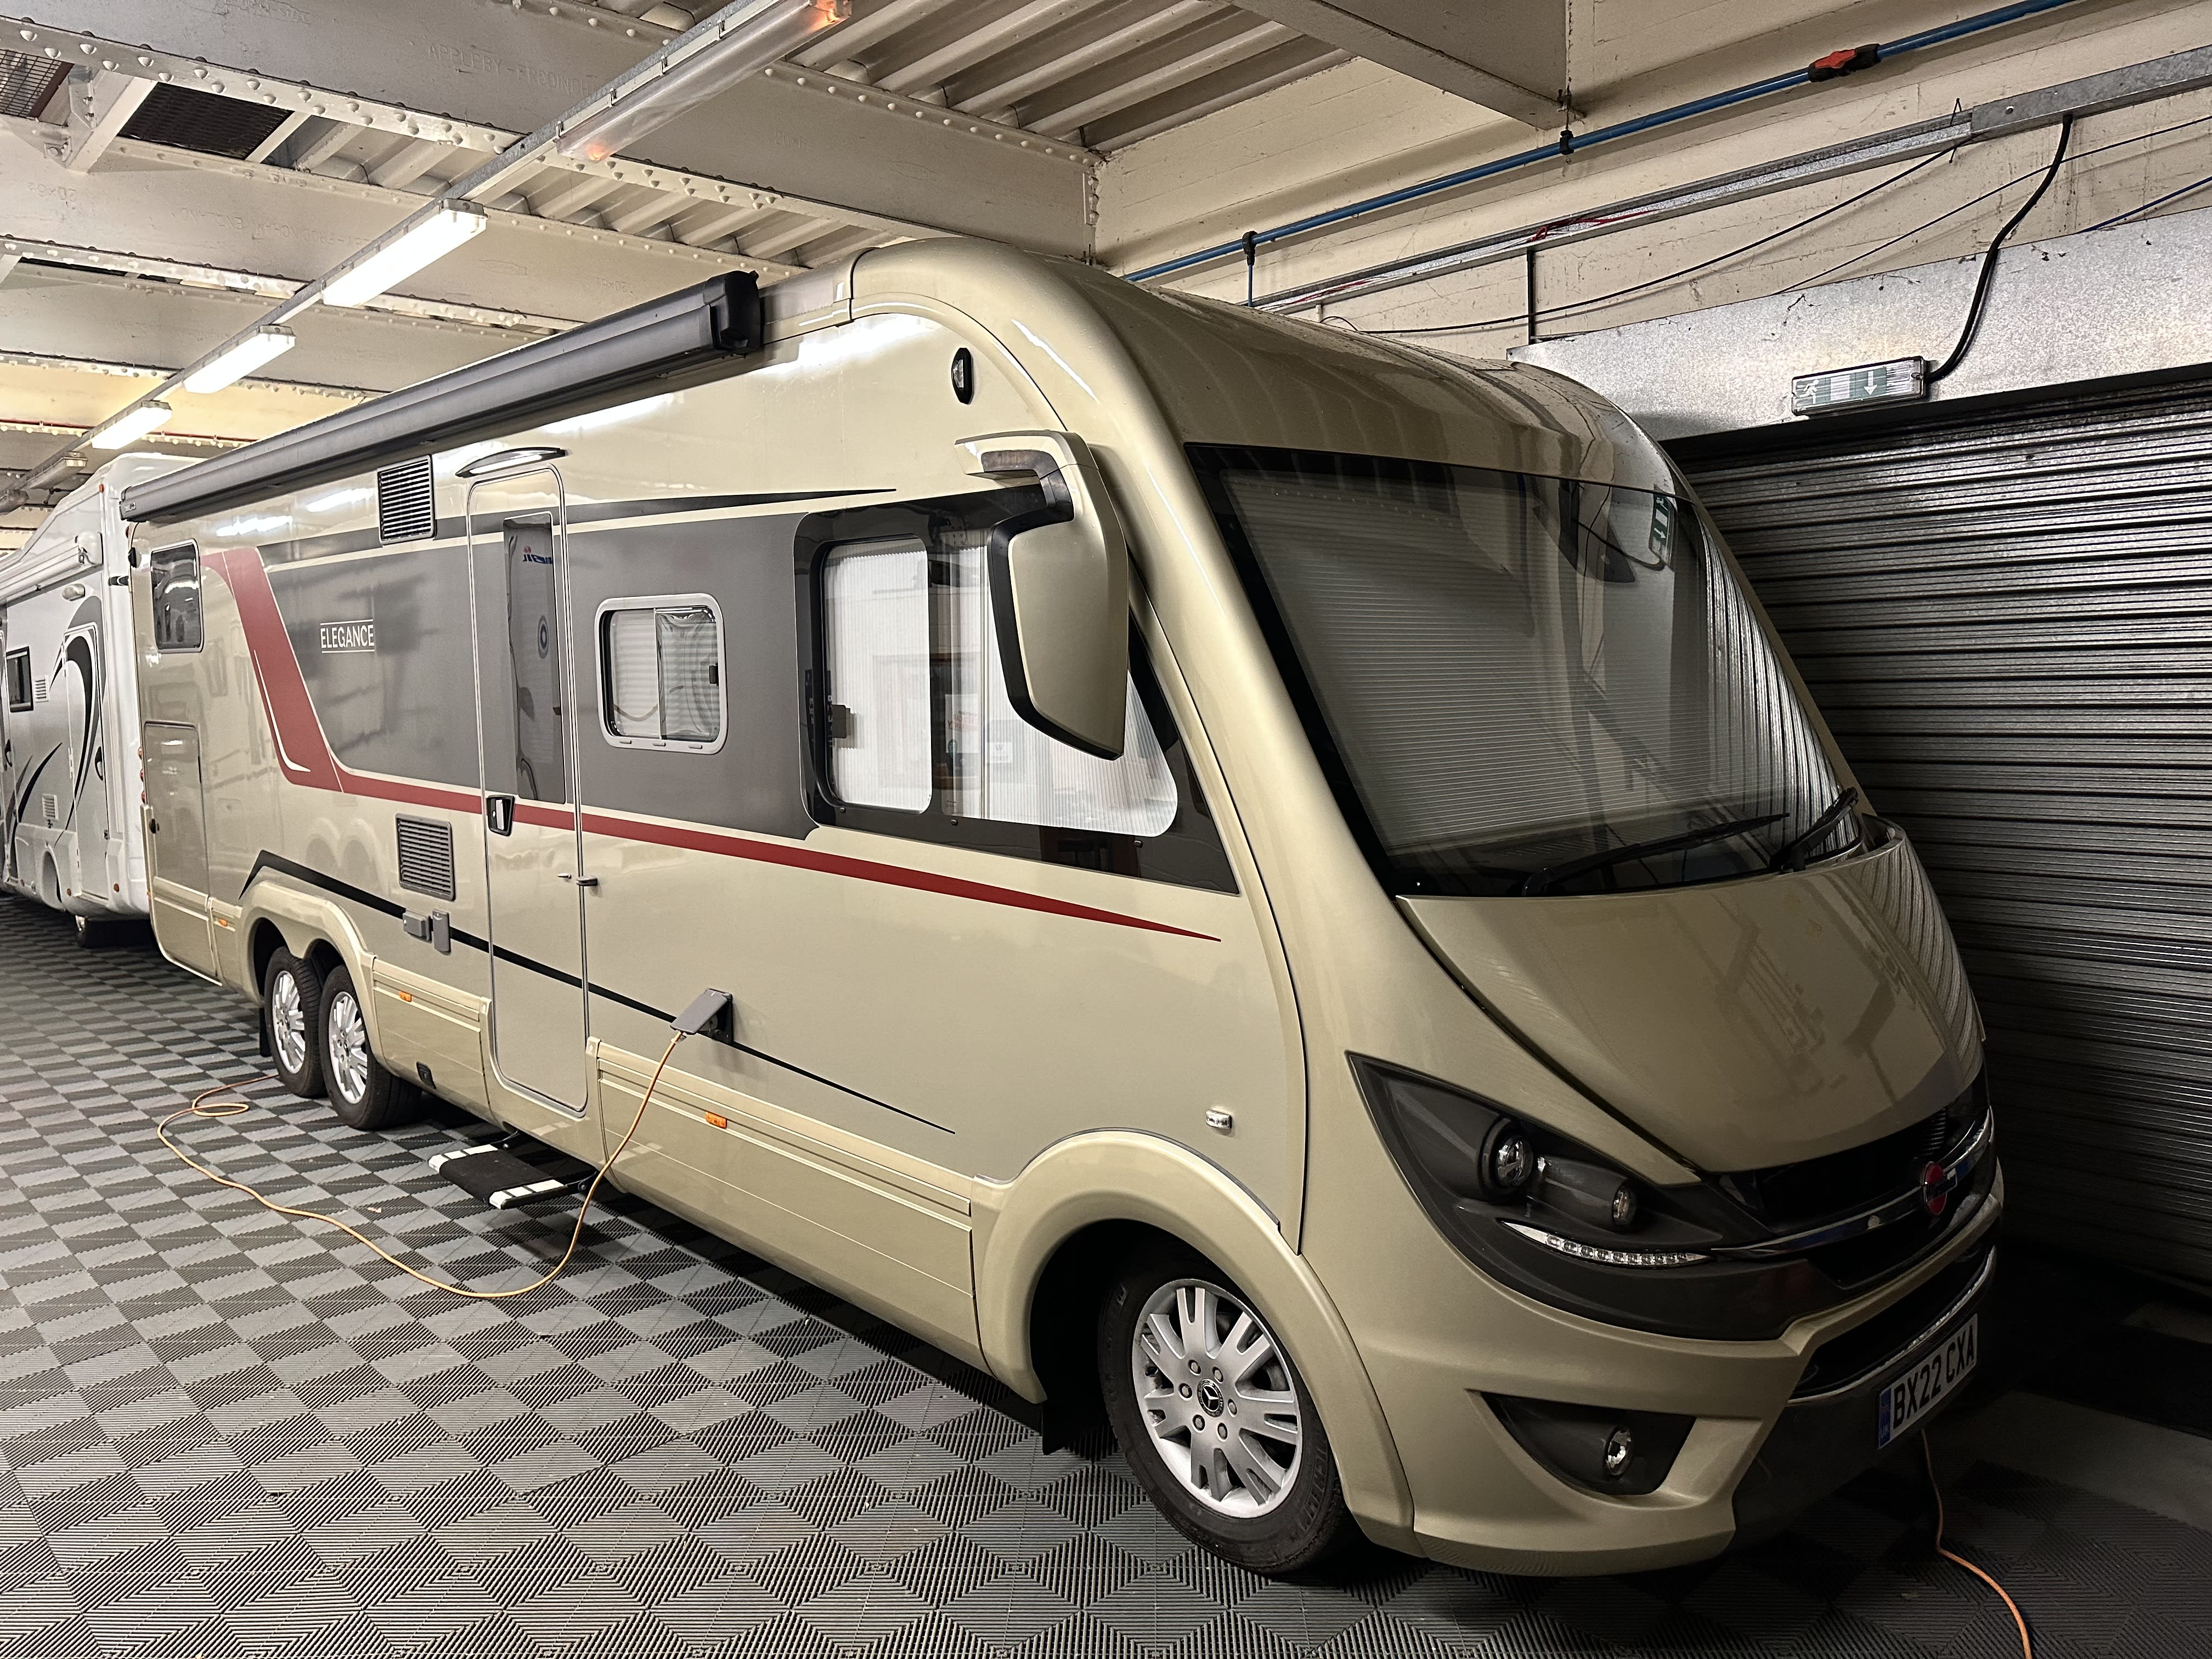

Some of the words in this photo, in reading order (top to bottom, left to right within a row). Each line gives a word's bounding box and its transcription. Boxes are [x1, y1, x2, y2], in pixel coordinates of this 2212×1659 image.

[320, 624, 375, 648] ELEGANCE
[1893, 1354, 1942, 1430] BX22
[1946, 1324, 1975, 1384] CXA
